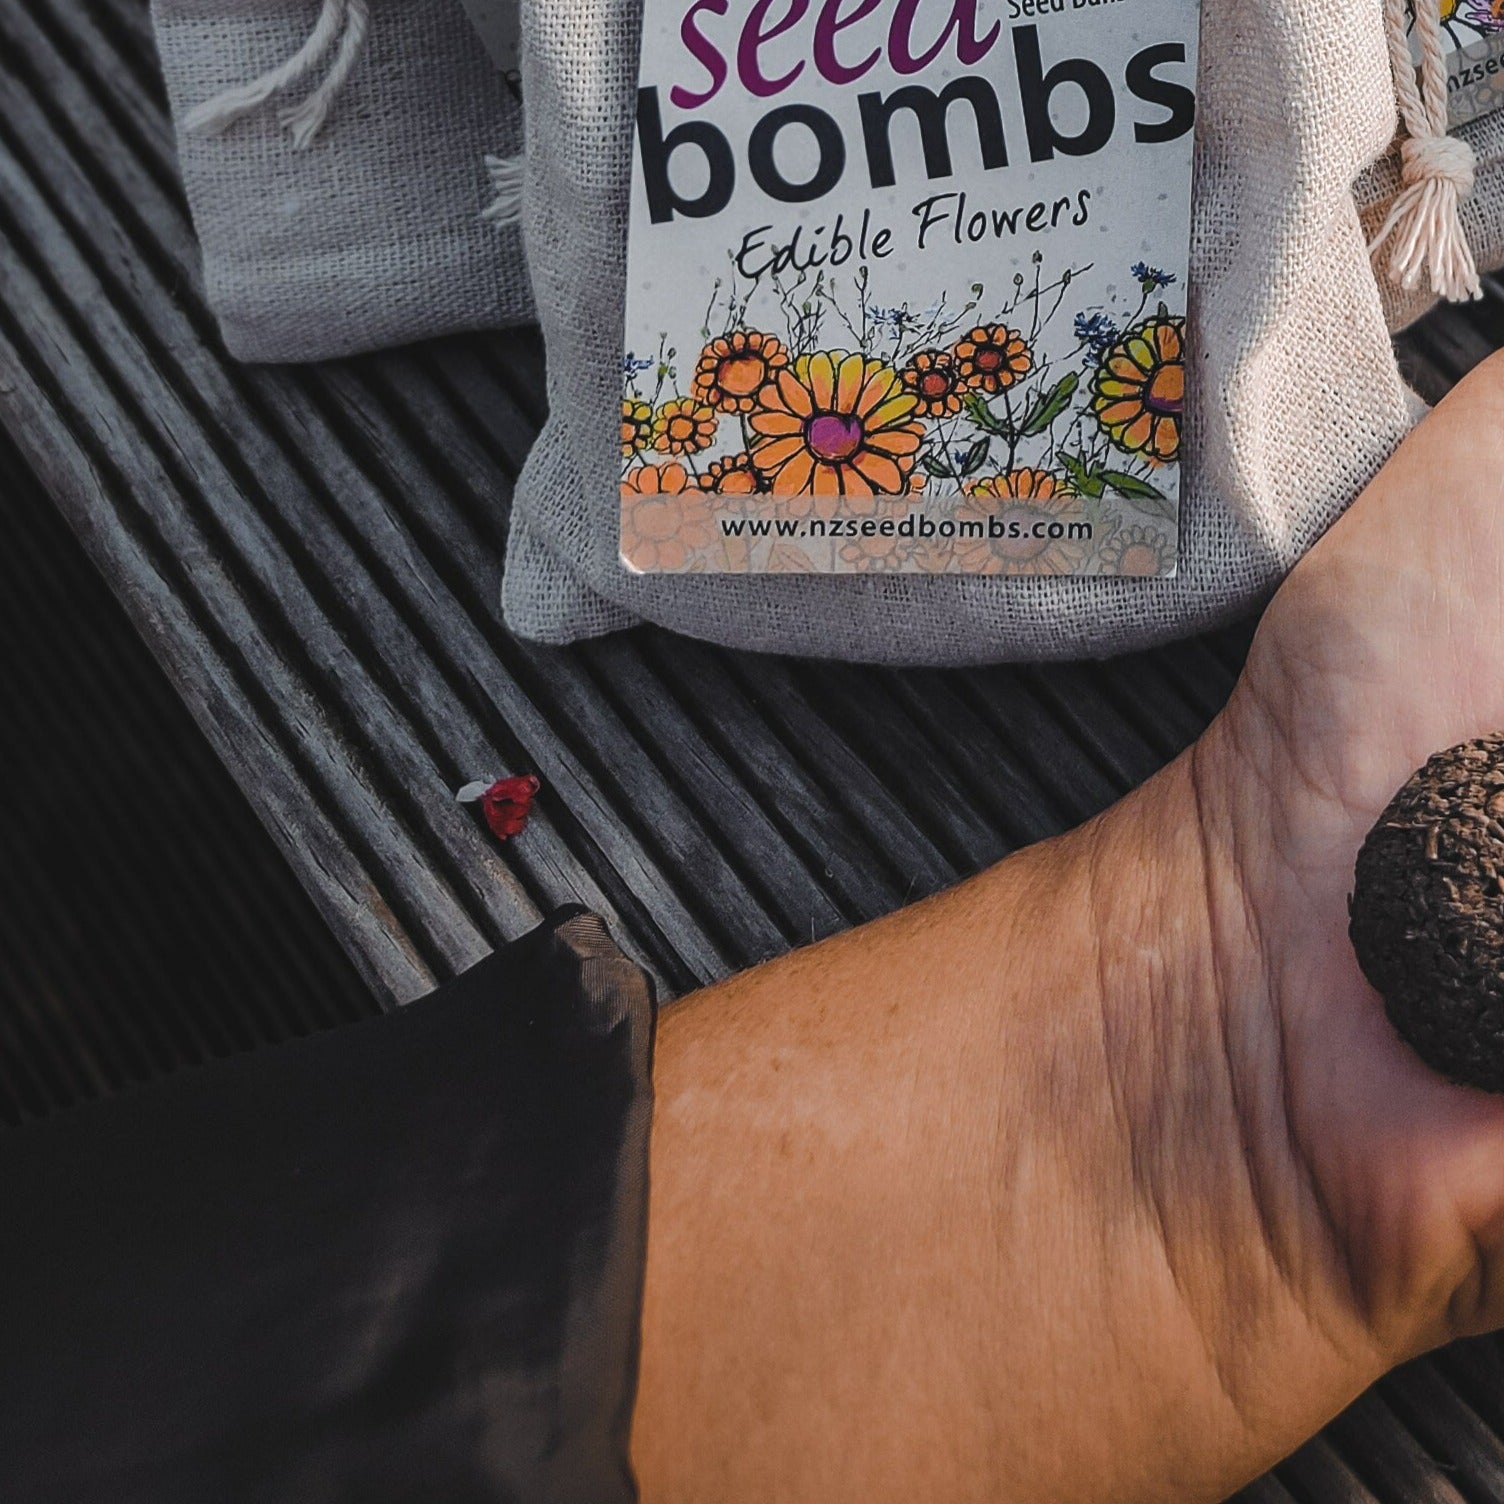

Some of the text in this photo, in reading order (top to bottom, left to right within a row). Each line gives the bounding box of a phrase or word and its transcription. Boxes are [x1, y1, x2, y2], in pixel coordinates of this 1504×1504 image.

[636, 24, 1196, 226] bombs
[735, 188, 1091, 281] Edible Flowers
[721, 513, 1094, 541] www.nzseedbombs.com
